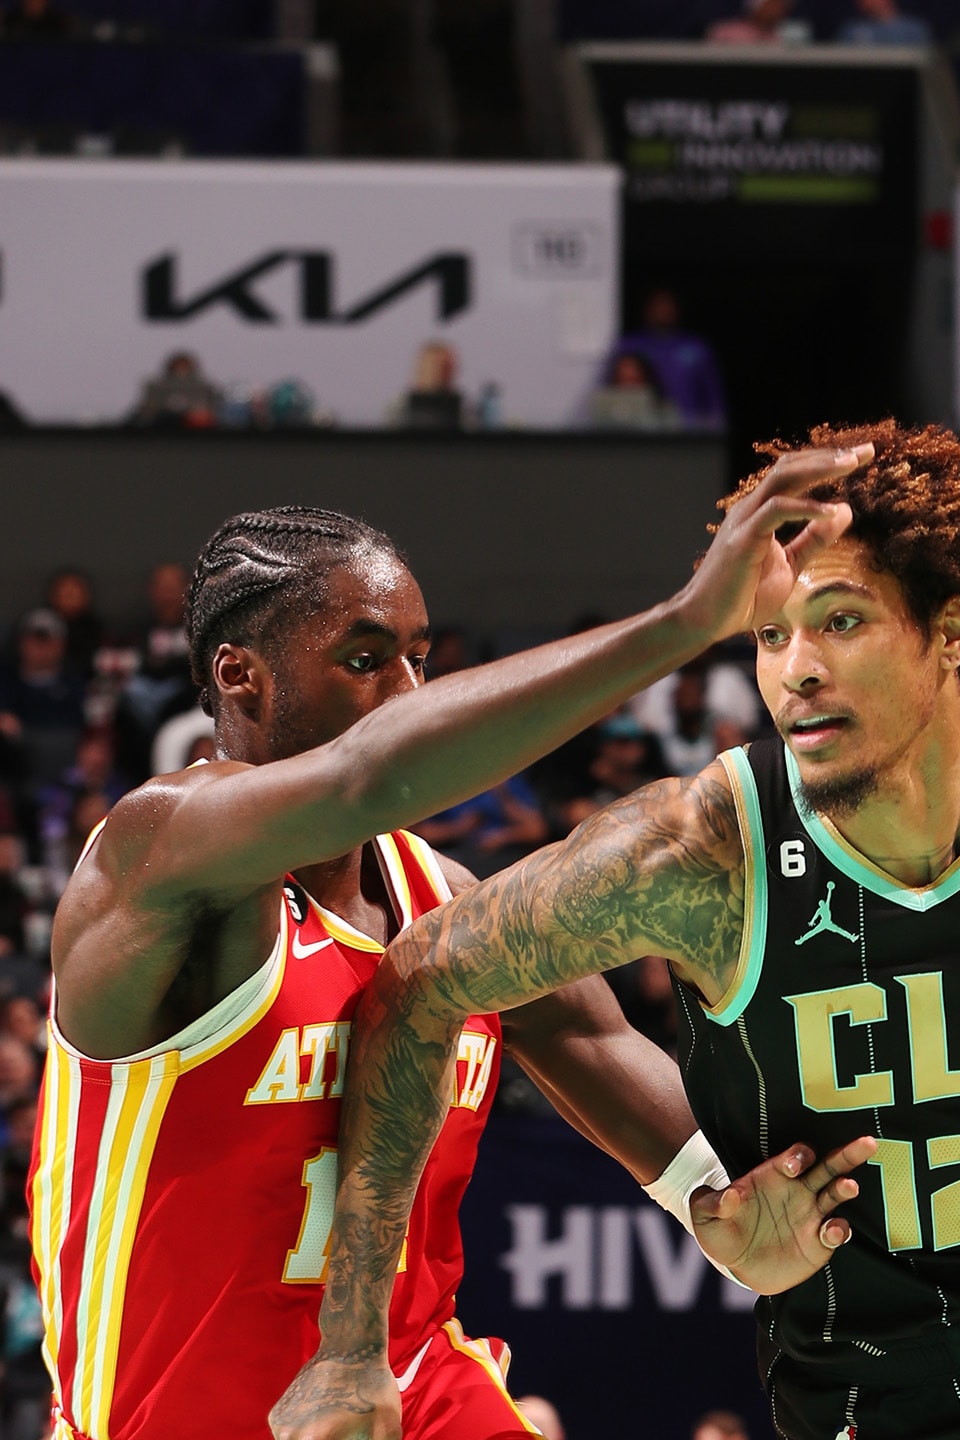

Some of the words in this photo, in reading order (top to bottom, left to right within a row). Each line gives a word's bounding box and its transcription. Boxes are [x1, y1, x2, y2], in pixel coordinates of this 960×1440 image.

[141, 247, 473, 327] KIA
[779, 839, 807, 878] 6
[500, 1203, 757, 1312] HIV
